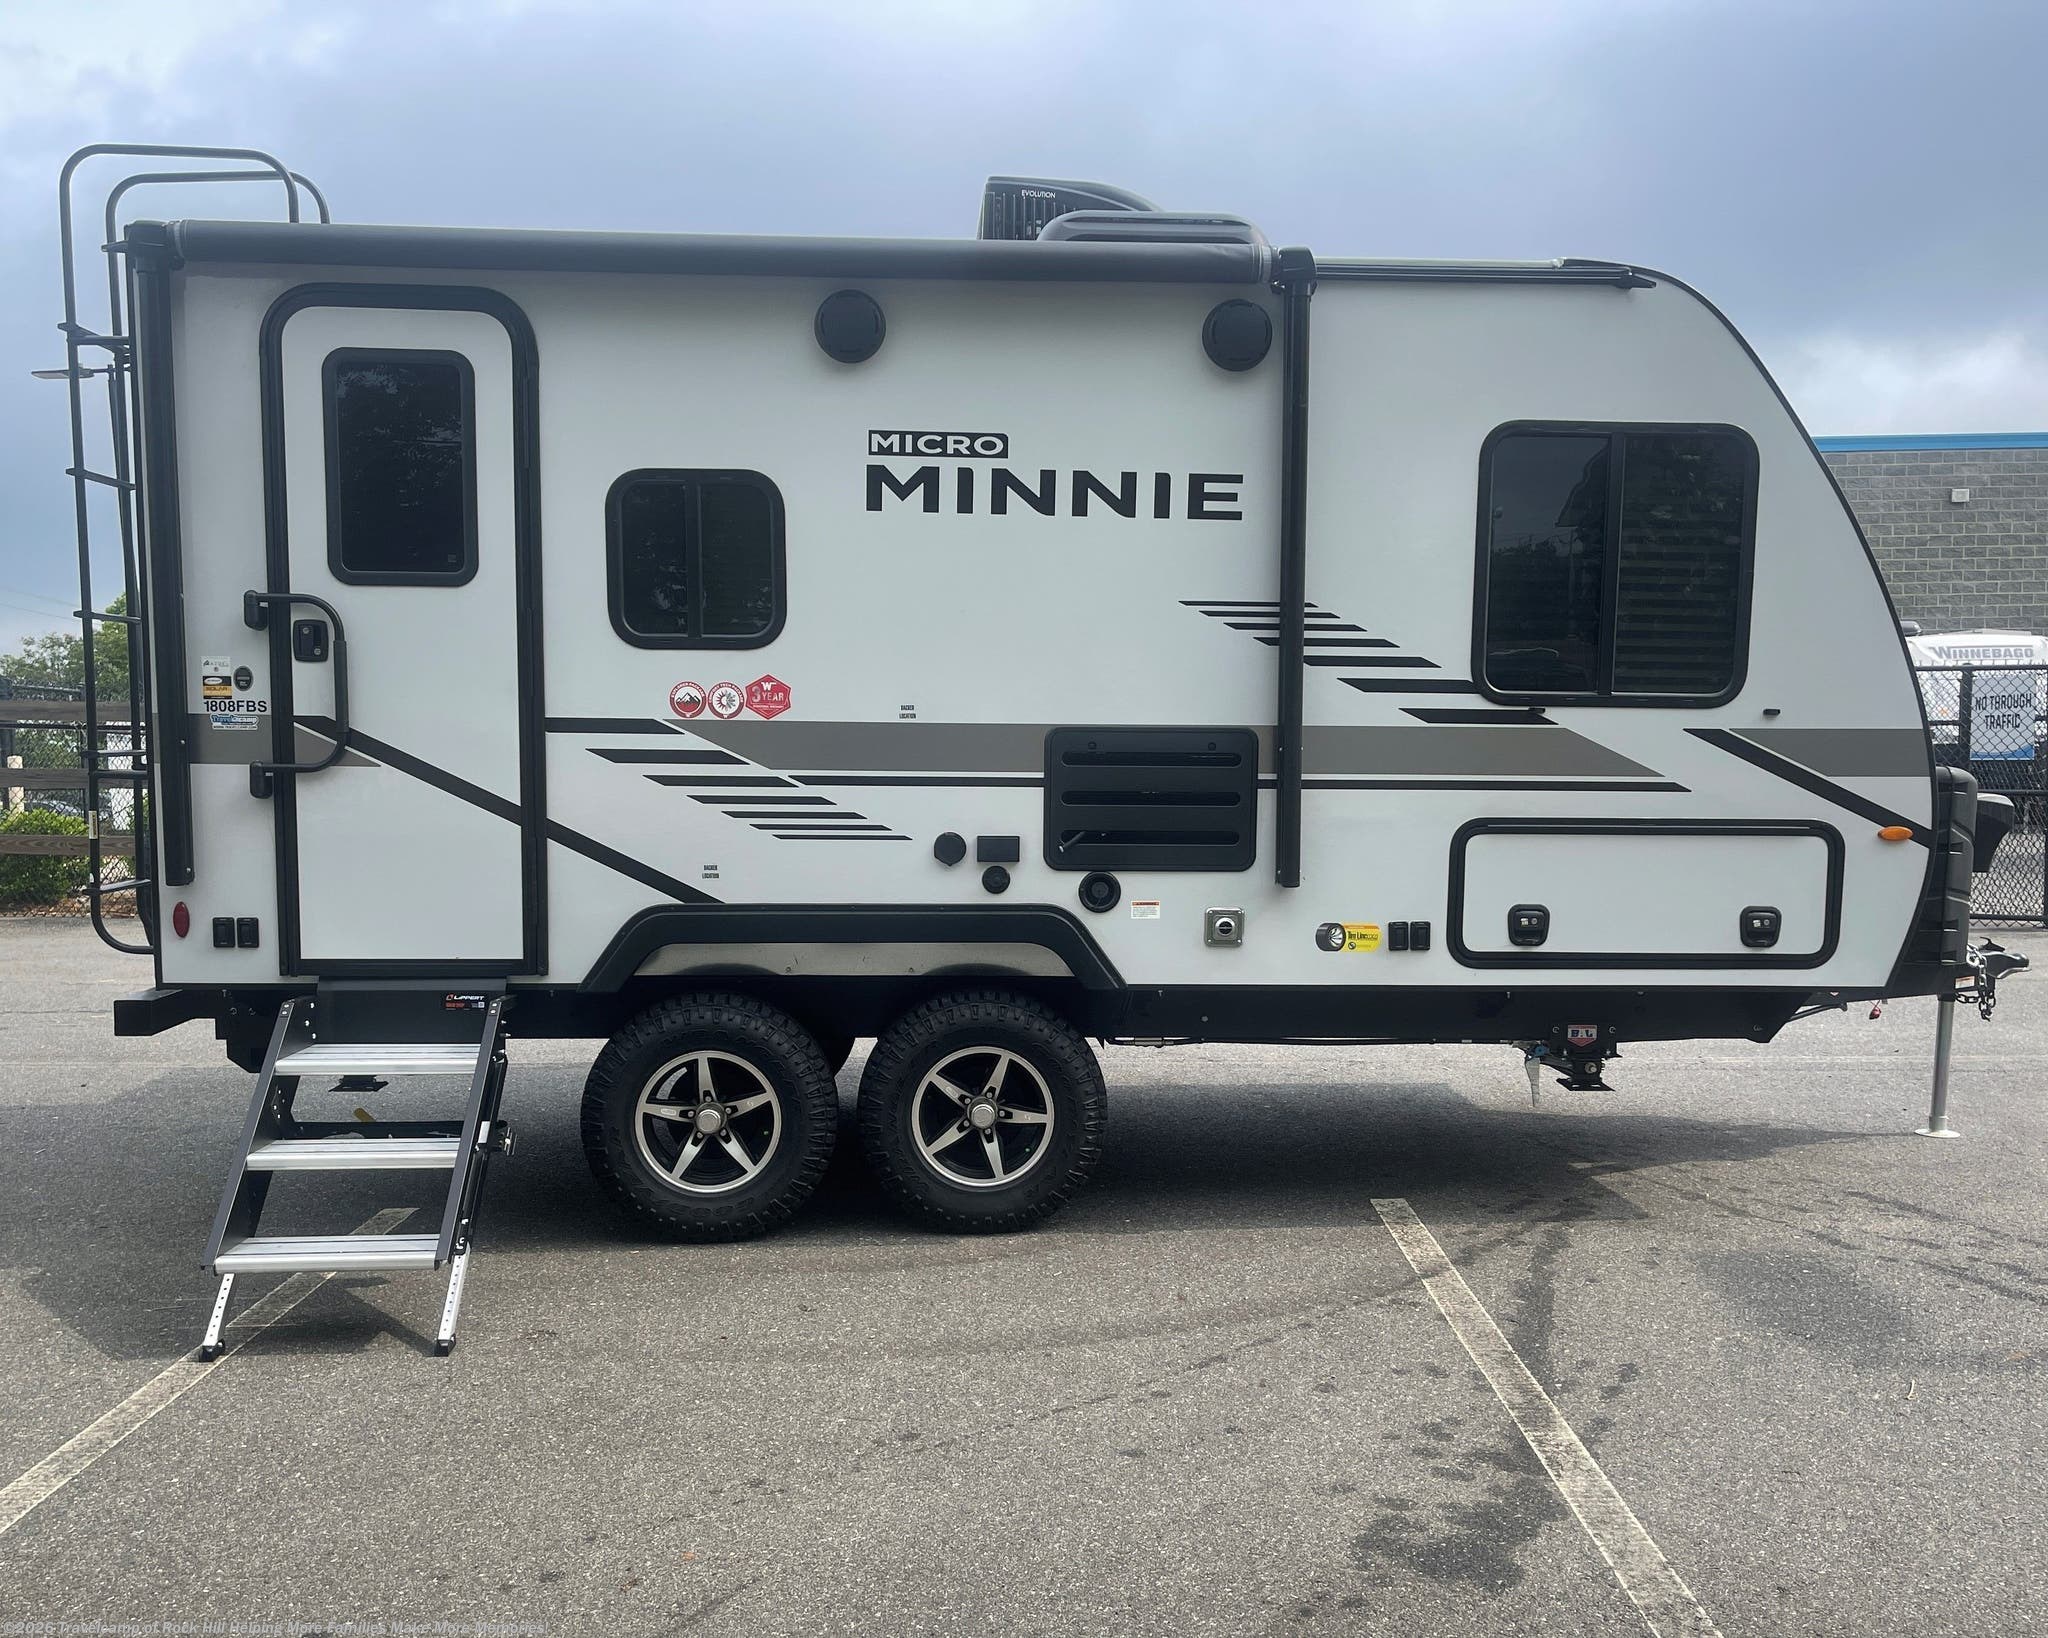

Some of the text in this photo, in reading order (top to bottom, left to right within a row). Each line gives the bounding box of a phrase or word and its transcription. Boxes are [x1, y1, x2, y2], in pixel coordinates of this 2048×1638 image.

[1021, 189, 1056, 199] EVOLUTION
[870, 433, 1004, 456] MICRO
[866, 464, 1244, 520] MINNIE
[1928, 644, 2034, 660] WINNEBAGO
[762, 692, 784, 702] YEAR
[1975, 693, 2032, 711] NO THROUGH
[203, 700, 268, 713] 1808FBS
[1984, 714, 2021, 730] TRAFFIC
